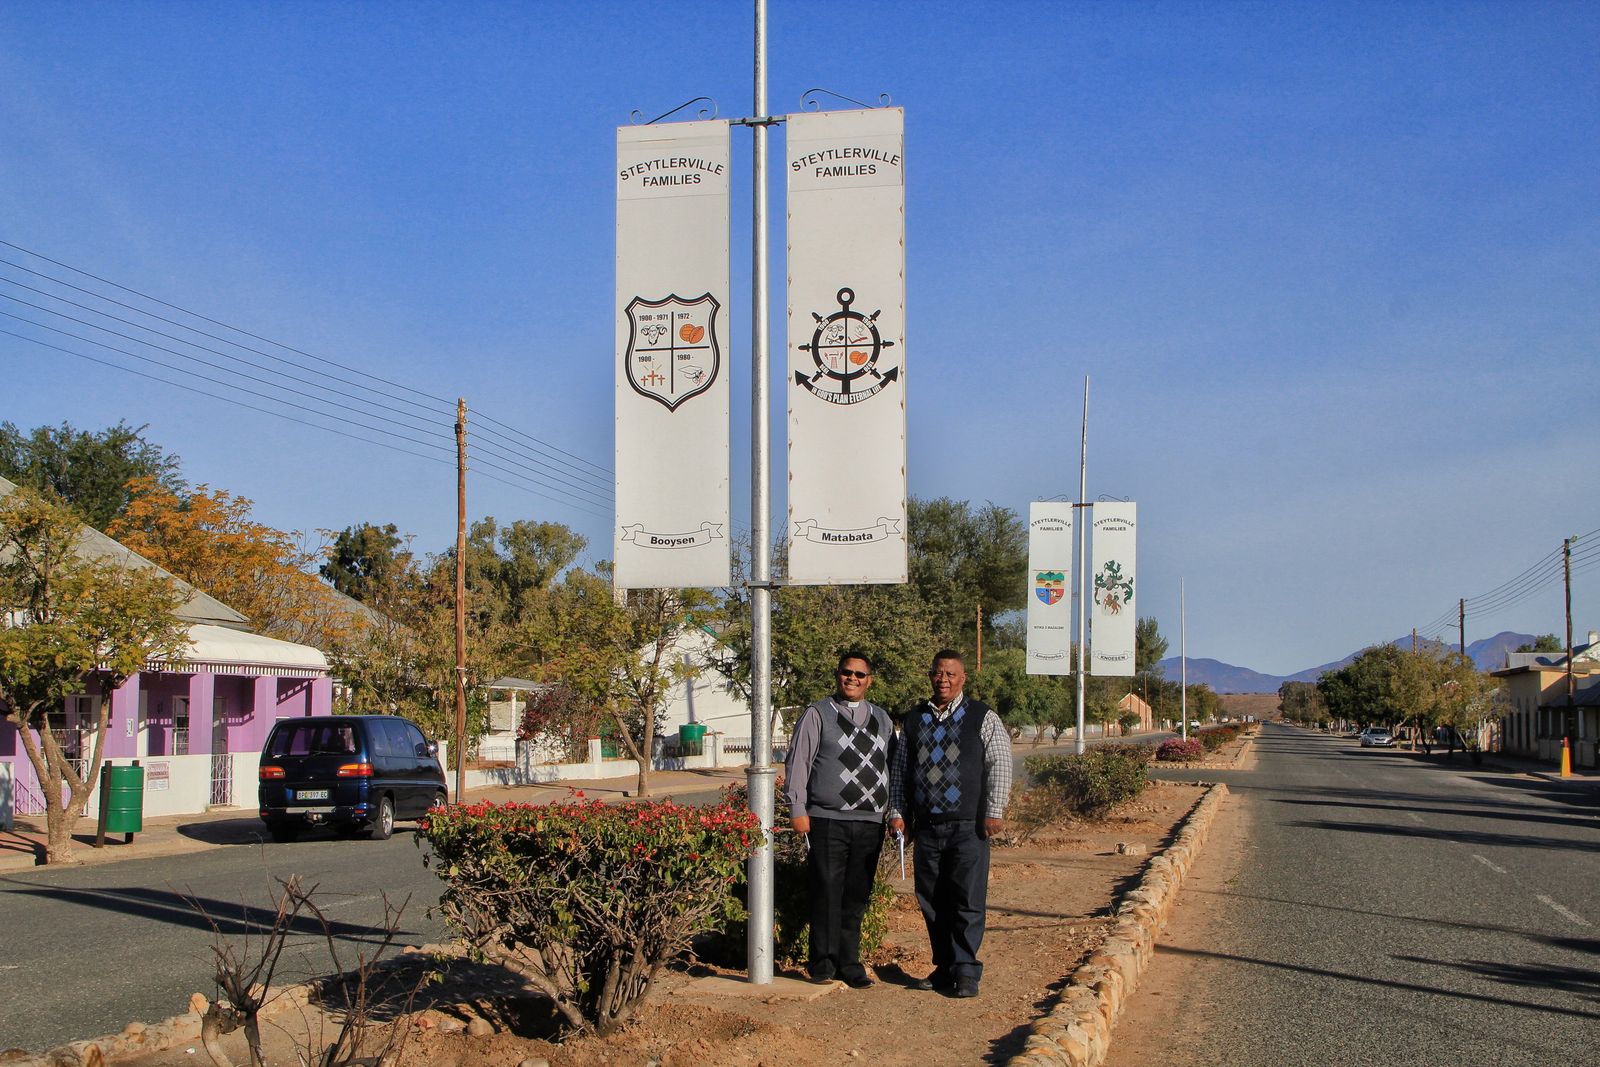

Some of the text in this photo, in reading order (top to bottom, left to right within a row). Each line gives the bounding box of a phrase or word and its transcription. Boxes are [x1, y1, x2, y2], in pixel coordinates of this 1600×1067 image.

[791, 147, 901, 172] STEYTLERVILLE
[620, 157, 725, 181] STEYTLERVILLE
[815, 164, 877, 178] FAMILIES
[643, 174, 701, 187] FAMILIES
[832, 394, 849, 404] PLAN
[849, 390, 874, 404] ETERNAL
[1031, 517, 1072, 527] STEYTLERVILLE
[1094, 517, 1135, 527] STEYTLERVILLE
[650, 535, 695, 547] Booysen
[821, 531, 874, 542] Matabata
